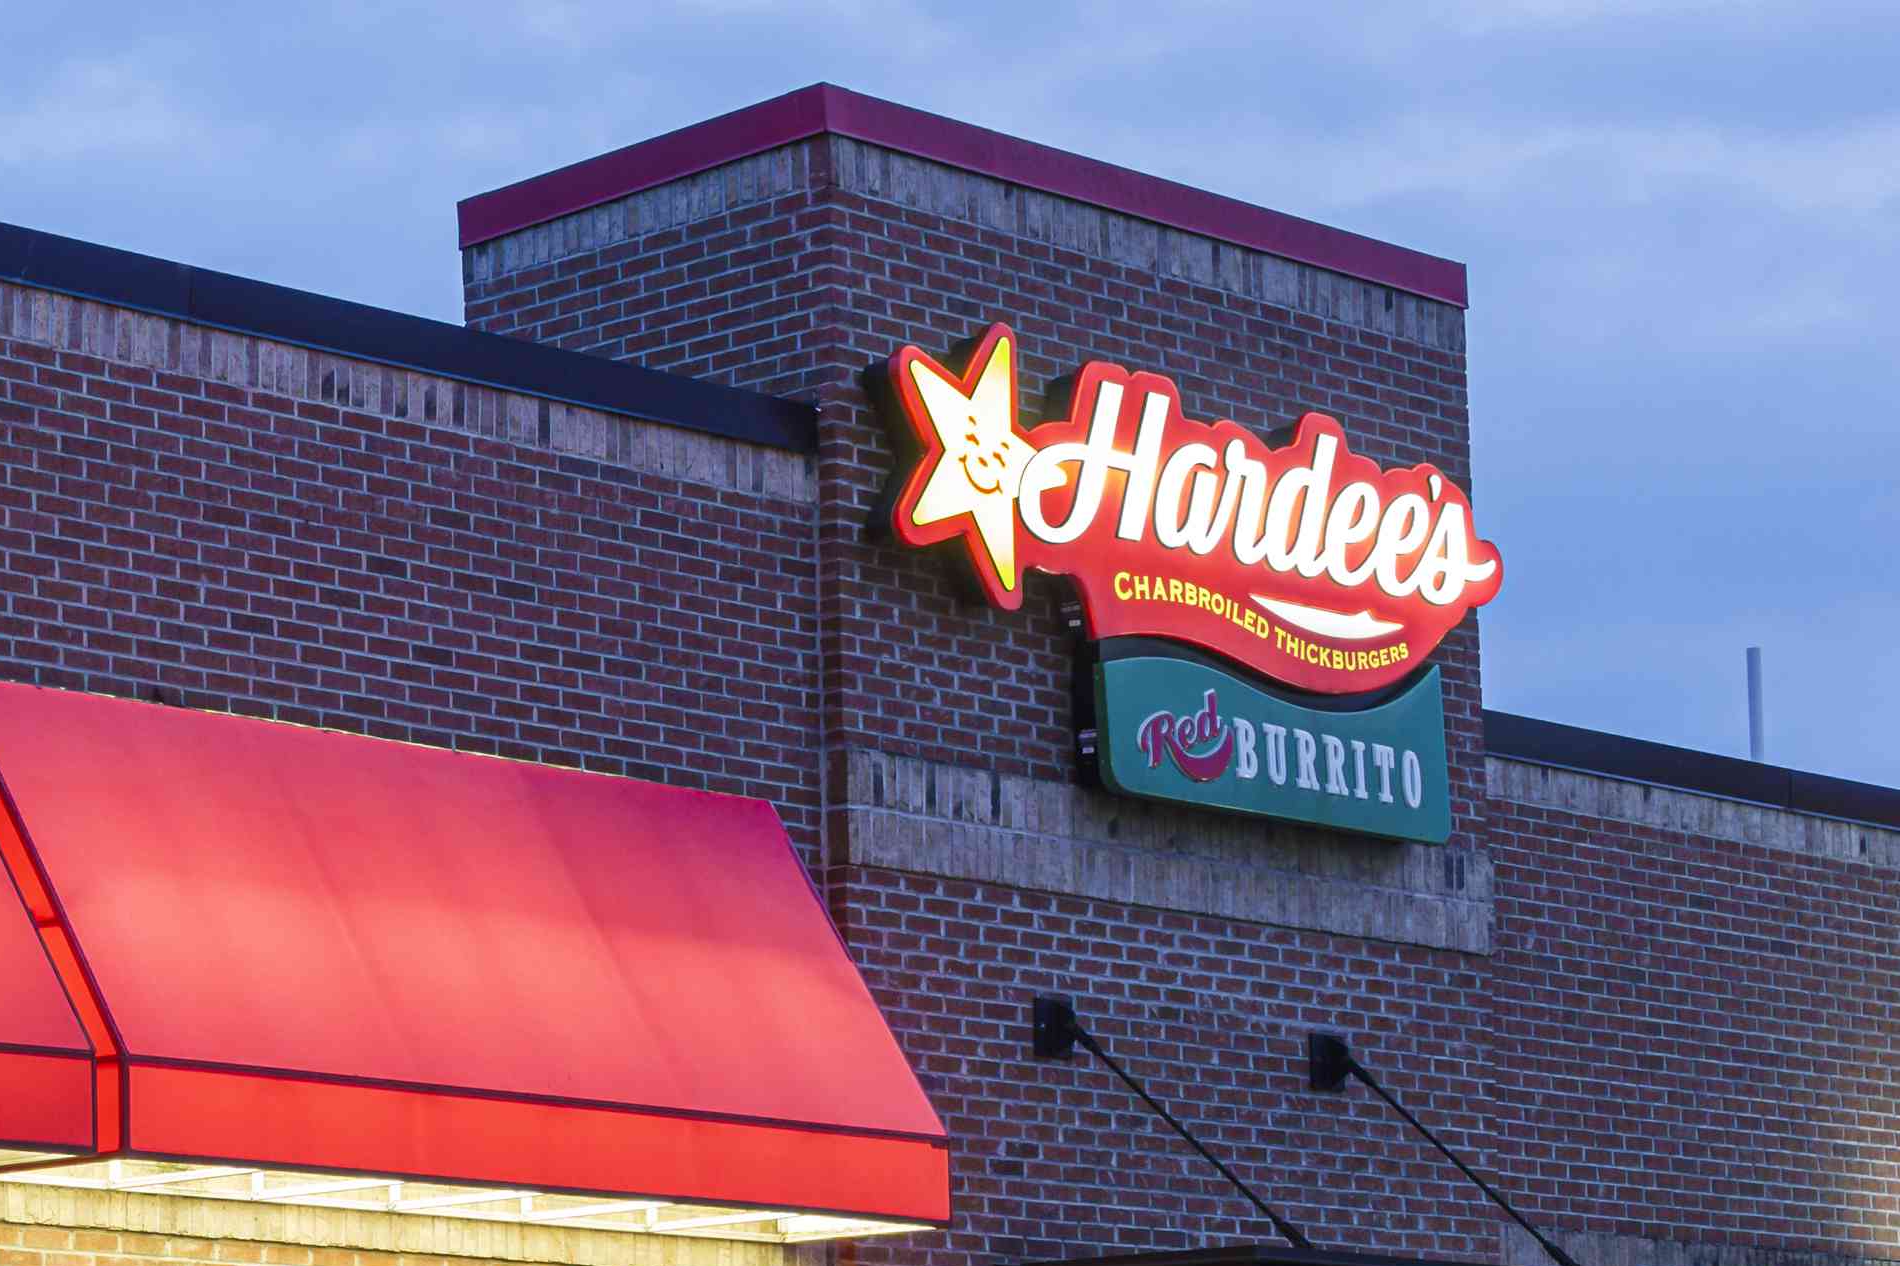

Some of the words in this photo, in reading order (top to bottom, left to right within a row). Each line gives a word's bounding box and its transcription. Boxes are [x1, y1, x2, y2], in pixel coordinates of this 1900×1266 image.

[1018, 381, 1495, 605] Hardee's
[1114, 572, 1269, 638] CHARBROILED
[1275, 626, 1409, 671] THICKBURGERS
[1137, 688, 1234, 782] Red
[1233, 716, 1422, 809] BURRITO
